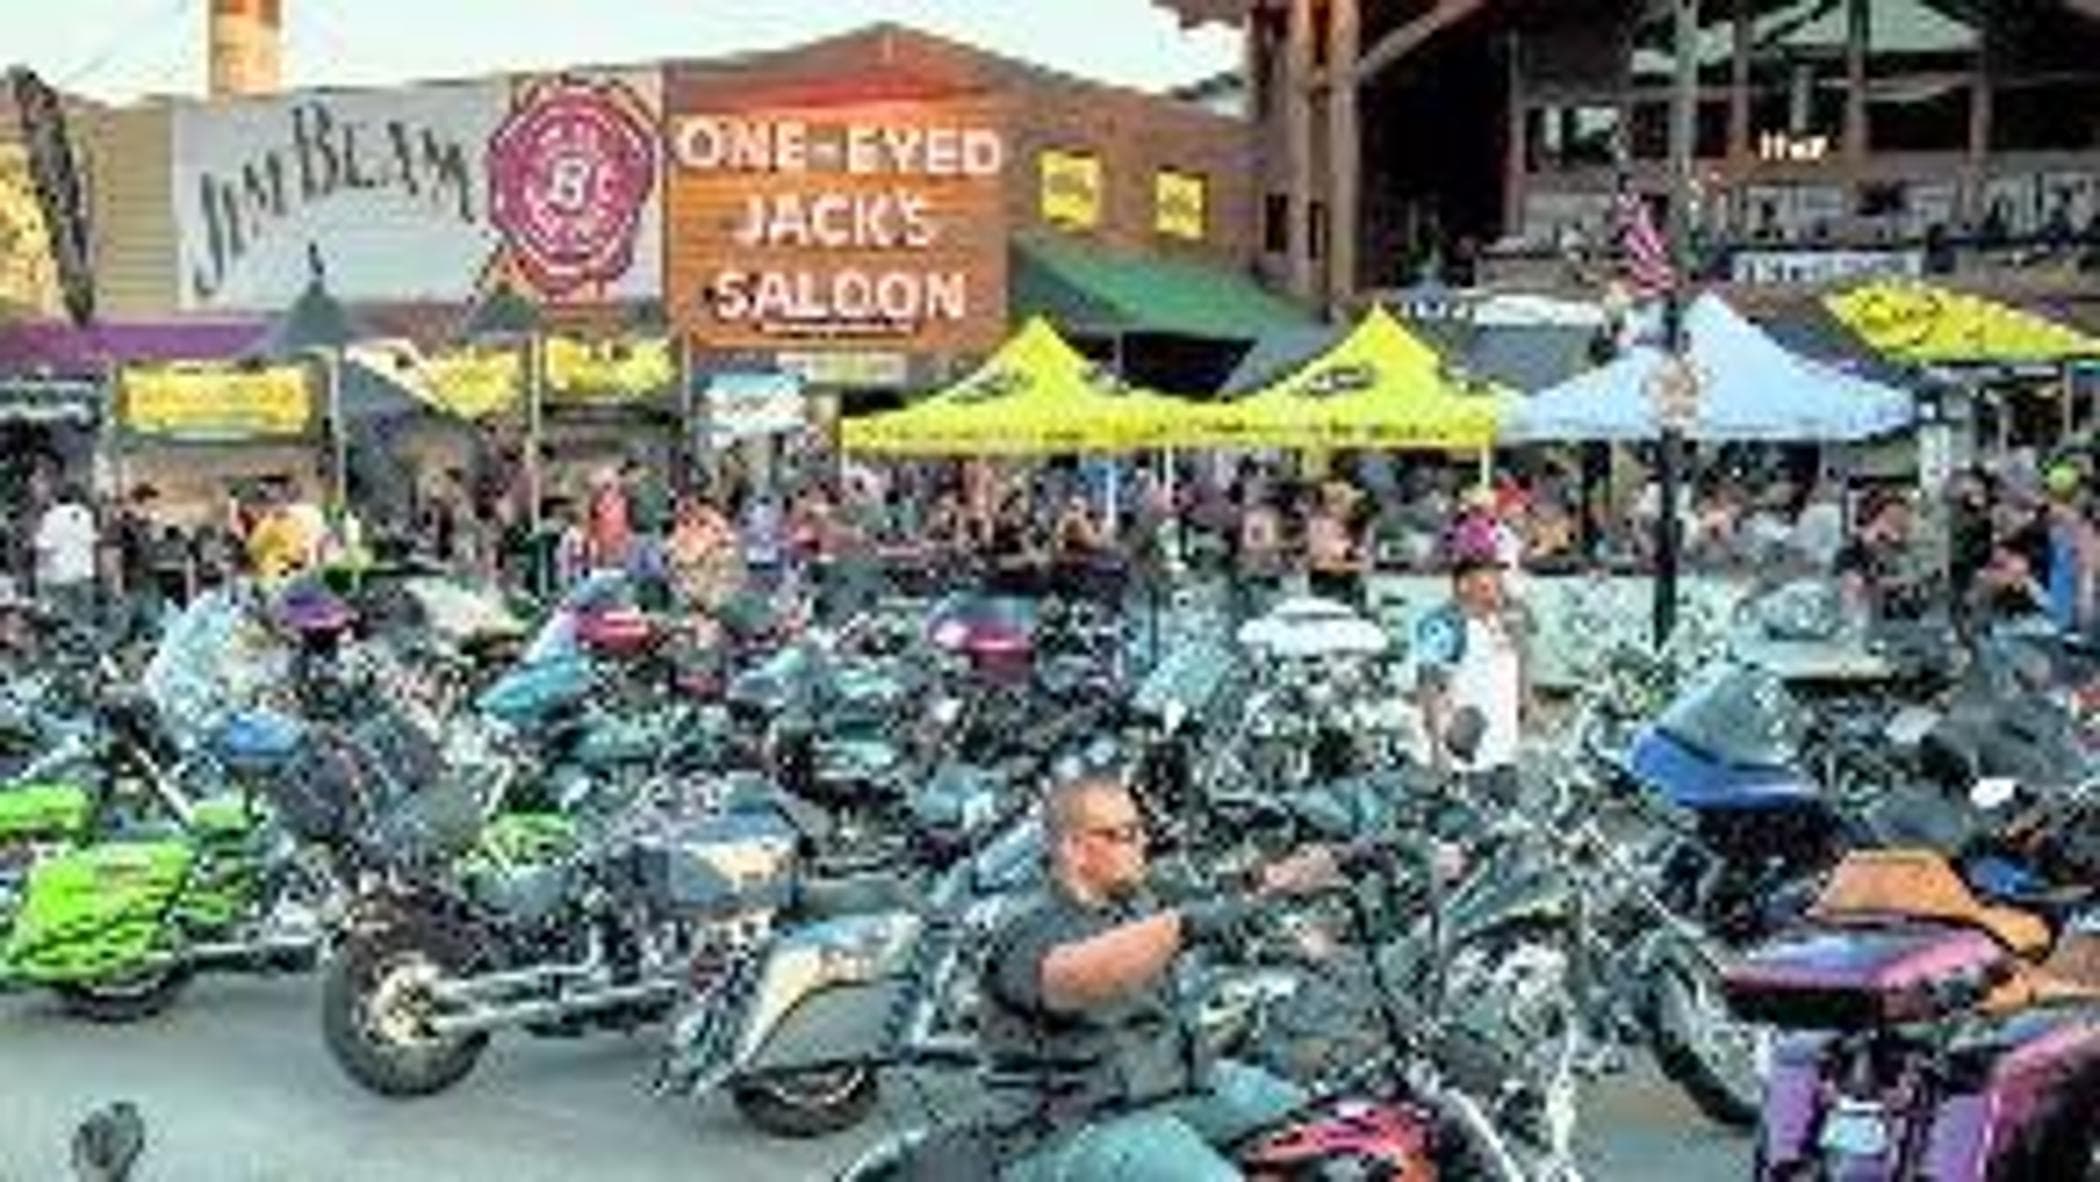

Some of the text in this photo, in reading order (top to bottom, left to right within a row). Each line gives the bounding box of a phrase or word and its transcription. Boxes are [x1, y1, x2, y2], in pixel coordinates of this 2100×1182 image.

[678, 116, 1001, 176] ONE-EYED
[193, 151, 287, 297] JIM
[291, 101, 475, 224] BEAM
[729, 189, 933, 248] JACK'S
[715, 271, 967, 320] SALOON
